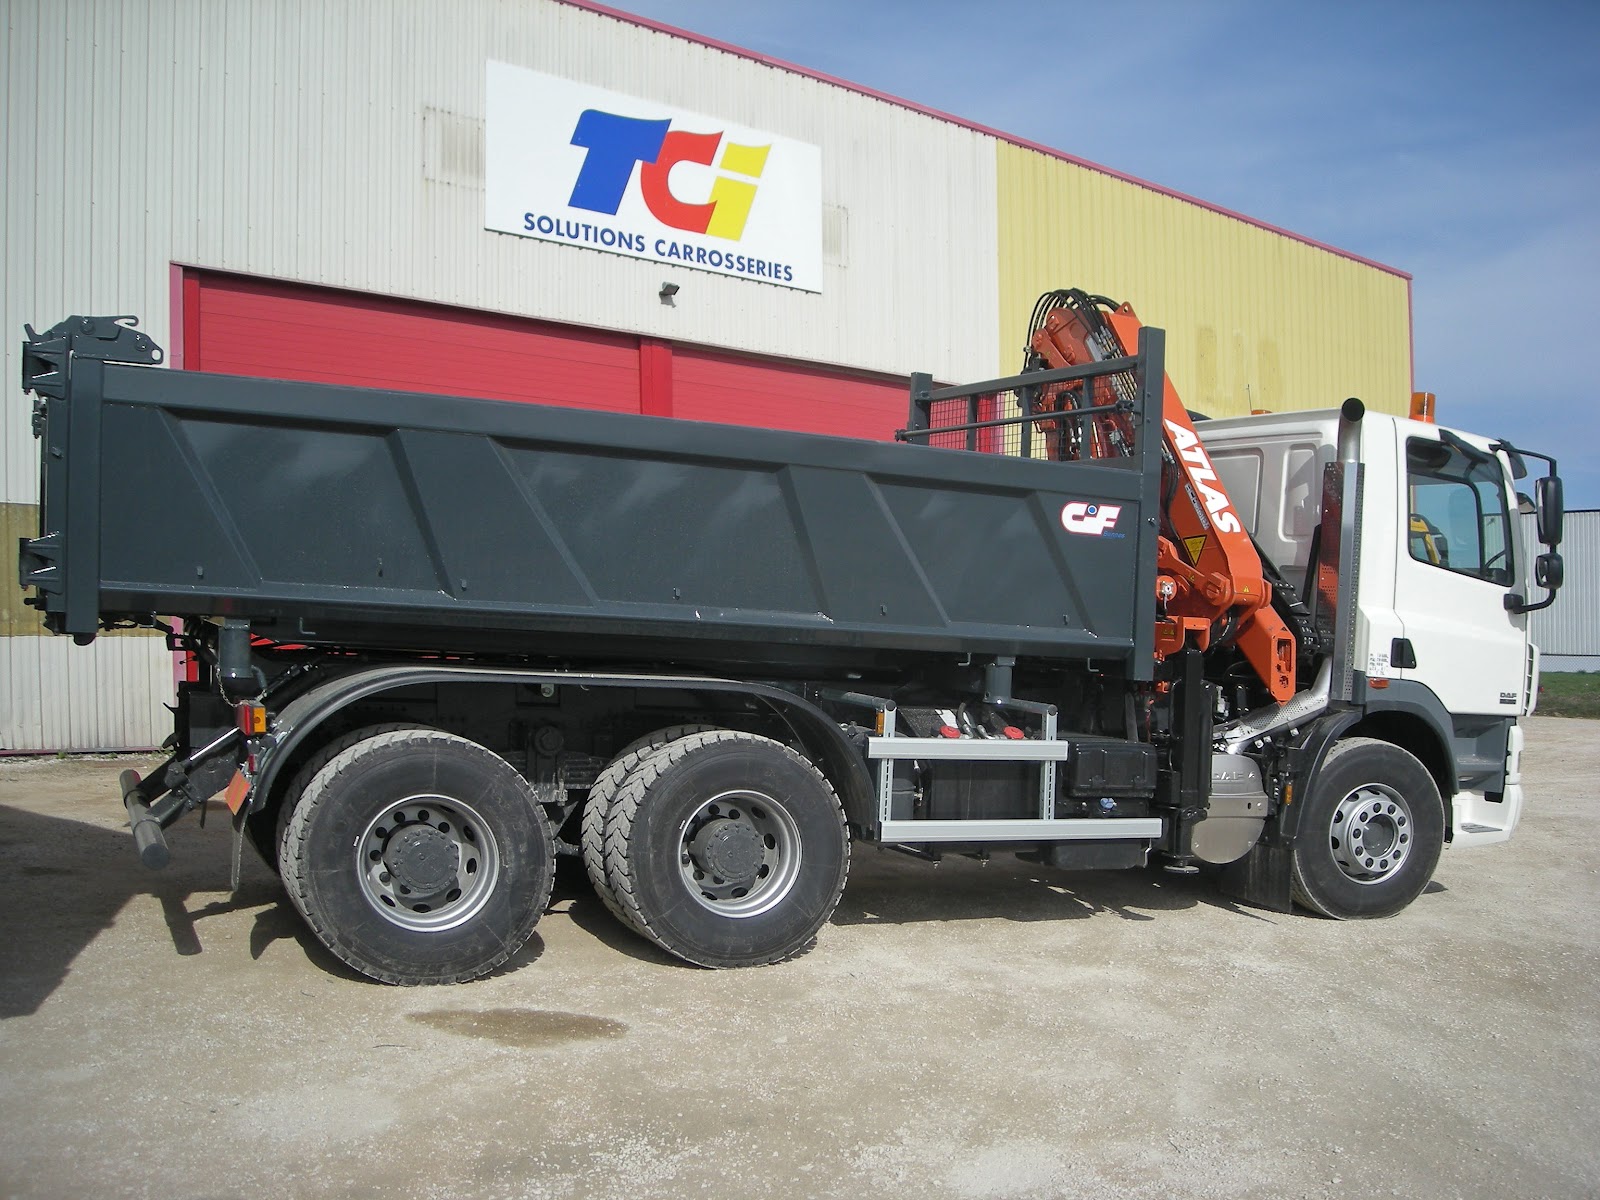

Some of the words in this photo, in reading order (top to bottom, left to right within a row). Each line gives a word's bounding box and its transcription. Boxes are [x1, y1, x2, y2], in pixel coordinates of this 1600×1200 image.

[524, 212, 645, 252] SOLUTIONS
[655, 239, 793, 281] CARROSSERIES
[1163, 418, 1242, 534] ATLAS
